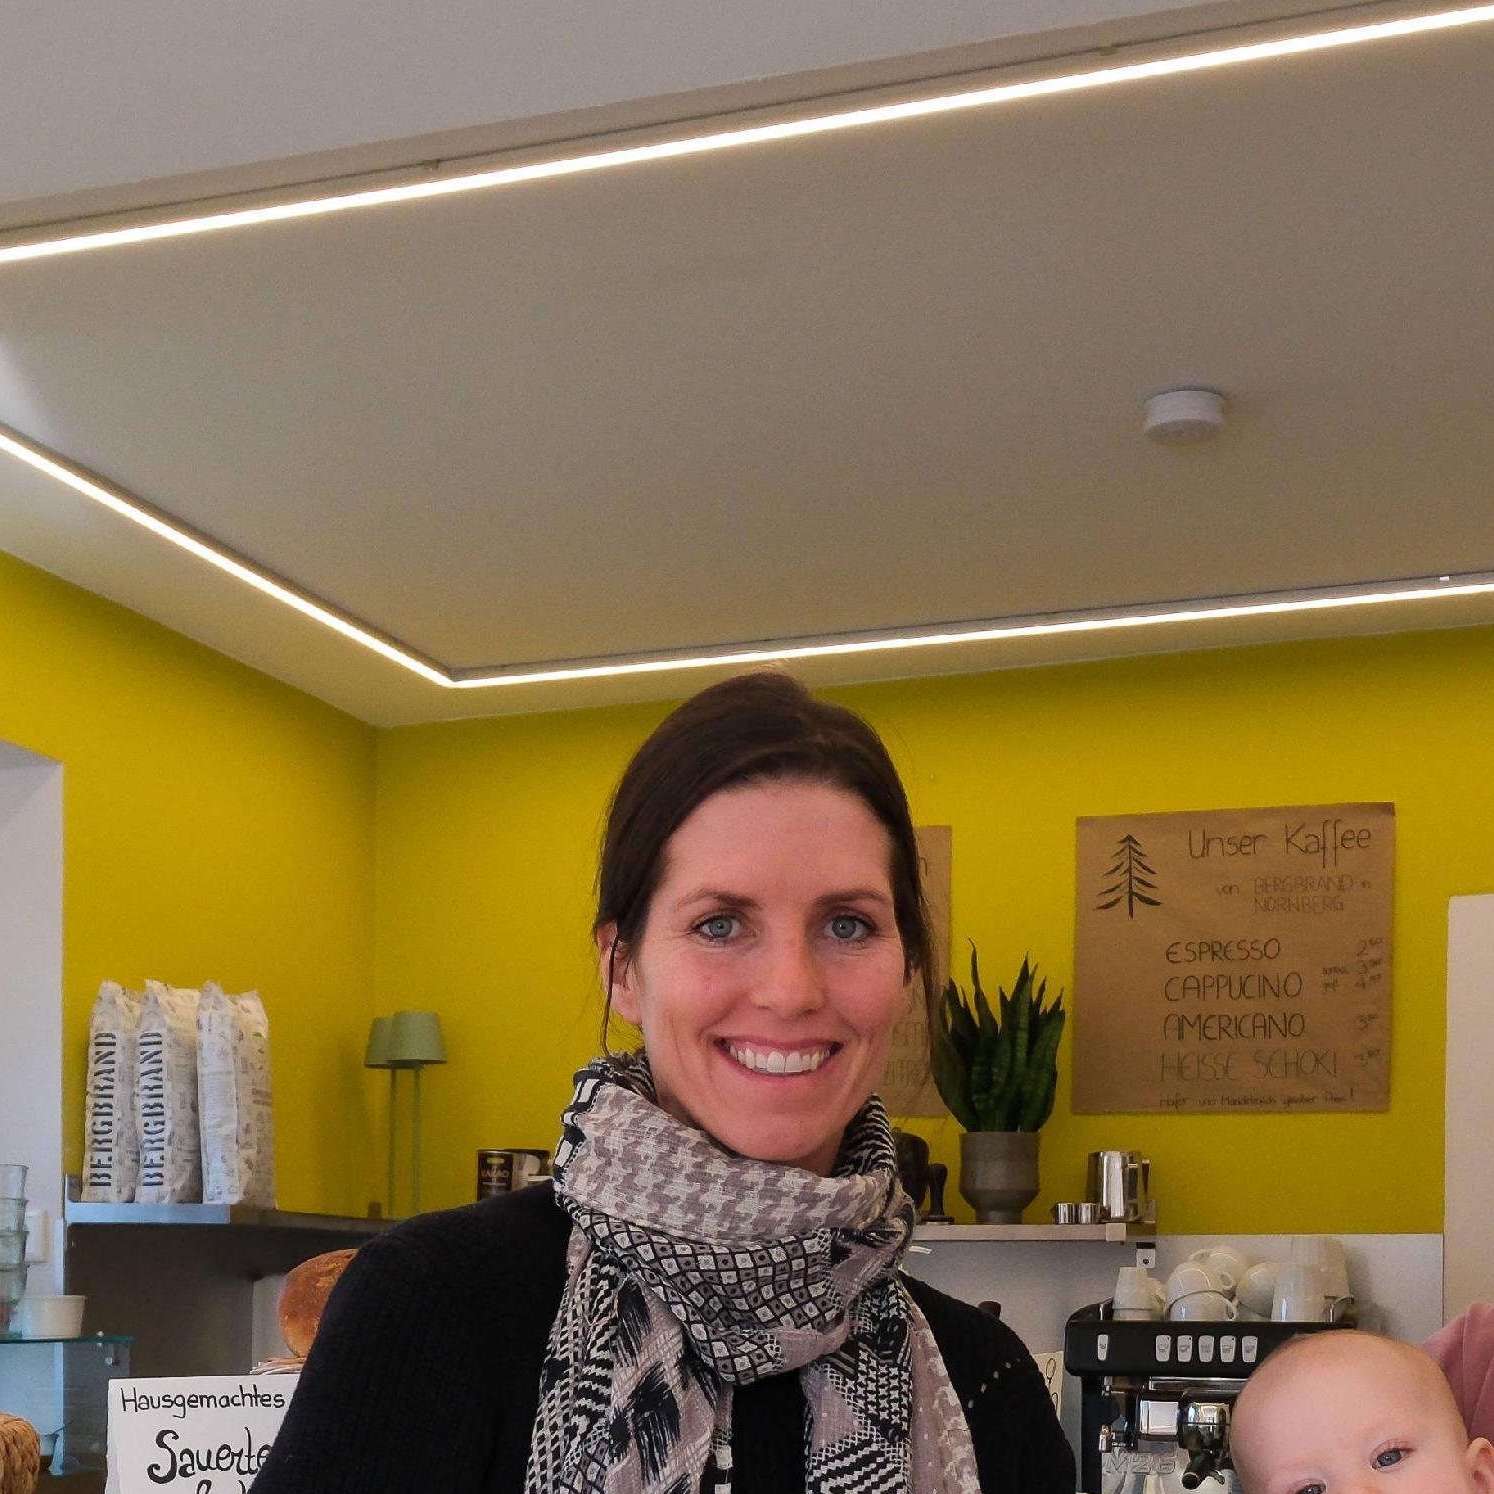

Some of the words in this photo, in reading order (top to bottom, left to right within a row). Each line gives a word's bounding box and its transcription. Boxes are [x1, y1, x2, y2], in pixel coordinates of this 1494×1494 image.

[1188, 828, 1267, 859] Unser
[1285, 819, 1371, 869] Kaffee
[1215, 884, 1239, 896] von
[1254, 873, 1353, 894] BERGBRAND
[1165, 938, 1281, 964] ESPRESSO
[1164, 972, 1303, 1001] CAPPUCINO
[1163, 1012, 1305, 1041] AMERICANO
[1160, 1050, 1236, 1083] HEISSE
[1254, 1048, 1337, 1081] SCHOKI
[90, 1032, 117, 1186] BERGBRAND
[139, 1032, 166, 1186] BERGBRAND
[120, 1384, 286, 1418] Hausgemachtes
[147, 1427, 274, 1485] Sauerte
